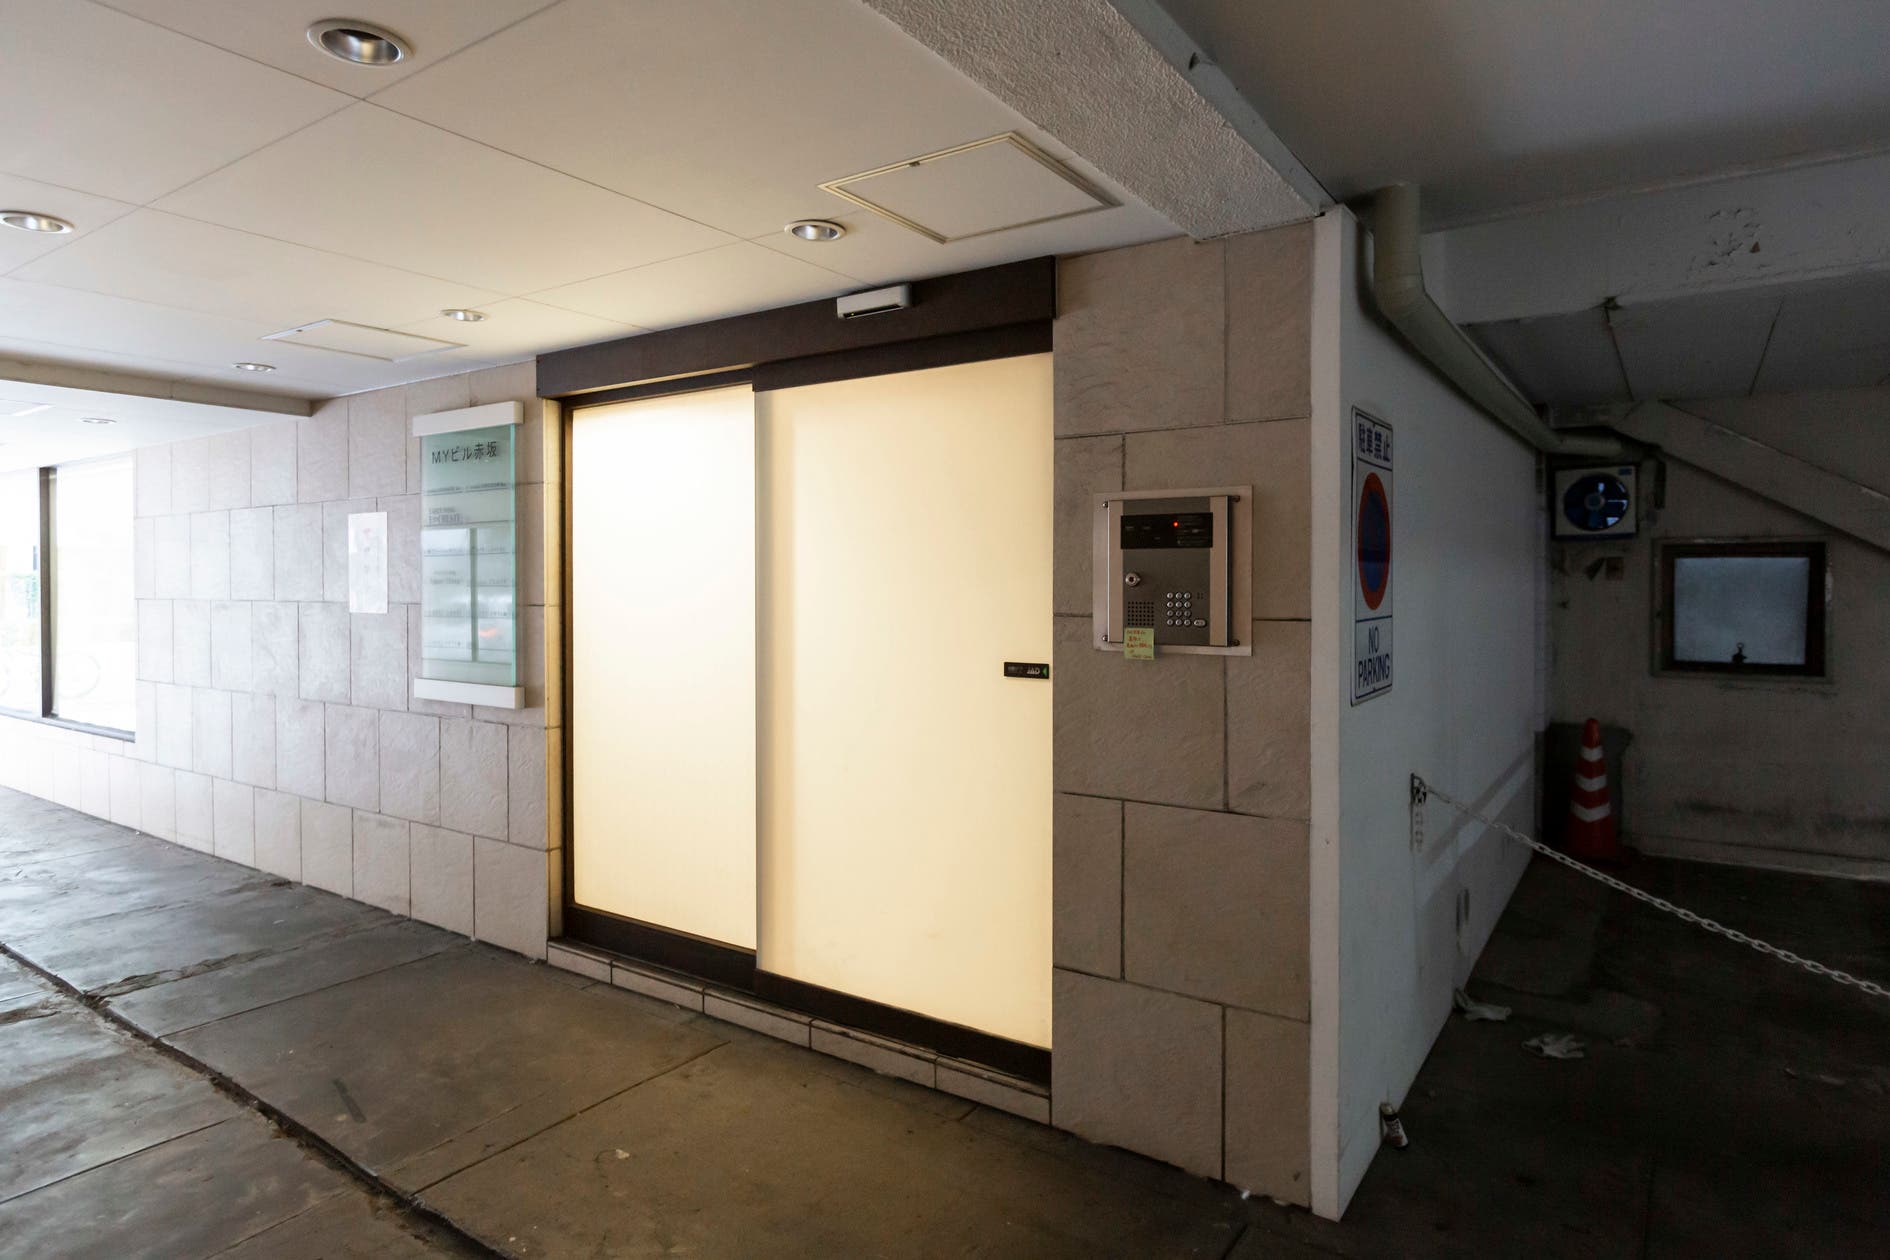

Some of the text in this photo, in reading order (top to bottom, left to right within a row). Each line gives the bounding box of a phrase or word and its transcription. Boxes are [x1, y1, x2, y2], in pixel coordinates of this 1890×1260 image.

[431, 441, 498, 465] MYビル赤坂
[1368, 626, 1380, 654] NO
[1358, 653, 1390, 689] PARKING
